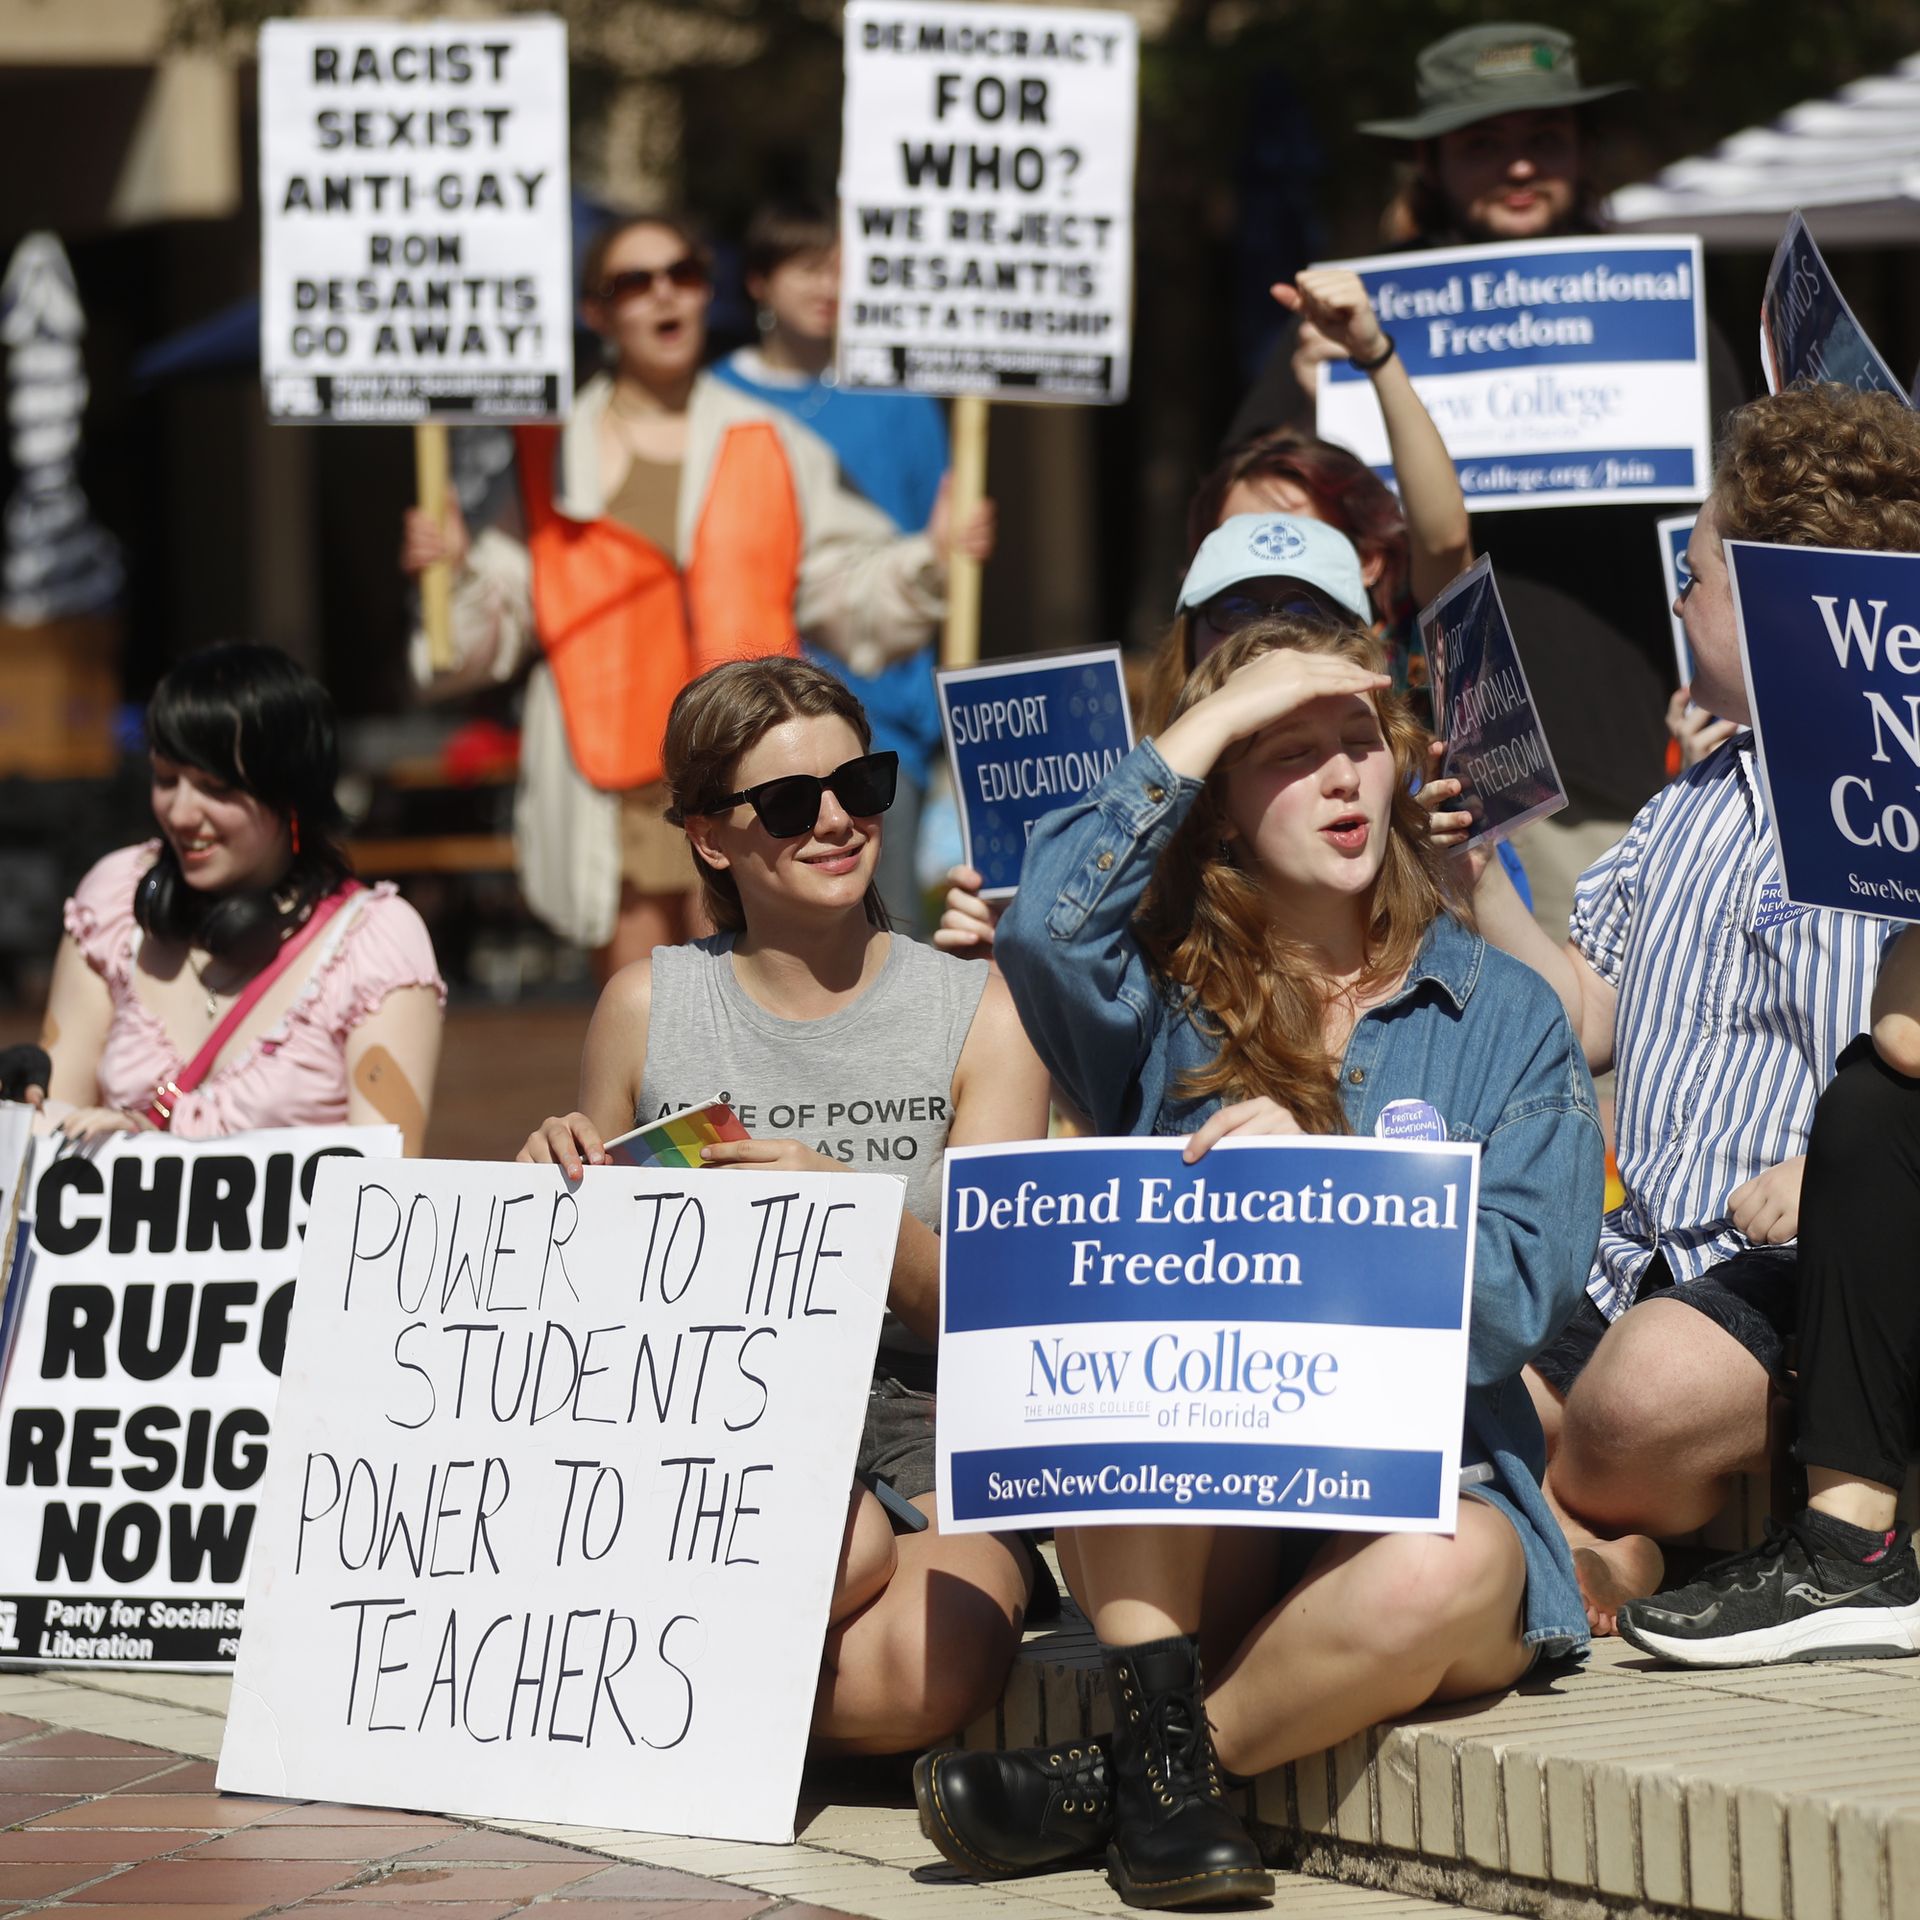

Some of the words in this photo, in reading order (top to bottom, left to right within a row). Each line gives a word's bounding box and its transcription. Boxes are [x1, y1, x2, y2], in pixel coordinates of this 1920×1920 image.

[314, 45, 511, 83] RACIST
[863, 23, 1117, 62] DEMOCRACY
[937, 75, 1047, 124] FOR
[316, 108, 510, 149] SEXIST
[903, 142, 1081, 197] WHO?
[371, 235, 460, 266] RON
[859, 207, 923, 239] WE
[949, 210, 1112, 248] REJECT
[296, 277, 536, 312] DESANTIS
[869, 256, 1094, 297] DESANTIS
[1370, 276, 1464, 320] fend
[1470, 262, 1690, 311] Educational
[292, 325, 348, 358] GO
[374, 325, 542, 358] AWAY!
[1429, 312, 1594, 357] Freedom
[1487, 375, 1621, 427] College
[1459, 457, 1656, 493] College.org/Join
[1811, 595, 1920, 675] We
[951, 695, 1048, 745] SUPPORT
[1445, 665, 1527, 743] UCATIONAL
[1467, 729, 1545, 800] FREEDOM
[1830, 774, 1920, 853] Co
[1755, 915, 1771, 926] OF
[1773, 906, 1810, 922] FLORI
[769, 1104, 815, 1128] OF
[827, 1096, 946, 1126] POWER
[867, 1135, 918, 1162] NO
[954, 1177, 1121, 1233] Defend
[1136, 1177, 1459, 1230] Educational
[344, 1184, 580, 1314] POWER
[634, 1192, 704, 1304] TO
[744, 1193, 856, 1318] THE
[1069, 1239, 1303, 1286] Freedom
[385, 1321, 778, 1432] STUDENTS
[1025, 1337, 1133, 1398] New
[1144, 1329, 1338, 1414] College
[1024, 1405, 1043, 1417] THE
[1047, 1402, 1095, 1416] HONORS
[1099, 1400, 1151, 1414] COLLEGE
[1157, 1405, 1180, 1428] of
[1188, 1402, 1271, 1429] Florida
[6, 1405, 270, 1492] RESIG
[988, 1465, 1371, 1507] SaveNewCollege.org/Join
[296, 1453, 511, 1577] POWER
[555, 1459, 624, 1567] TO
[661, 1457, 773, 1566] THE
[36, 1501, 257, 1583] NOW
[44, 1599, 107, 1634] Party
[109, 1599, 146, 1628] for
[38, 1630, 154, 1660] Liberation
[330, 1598, 700, 1750] TEACHERS
